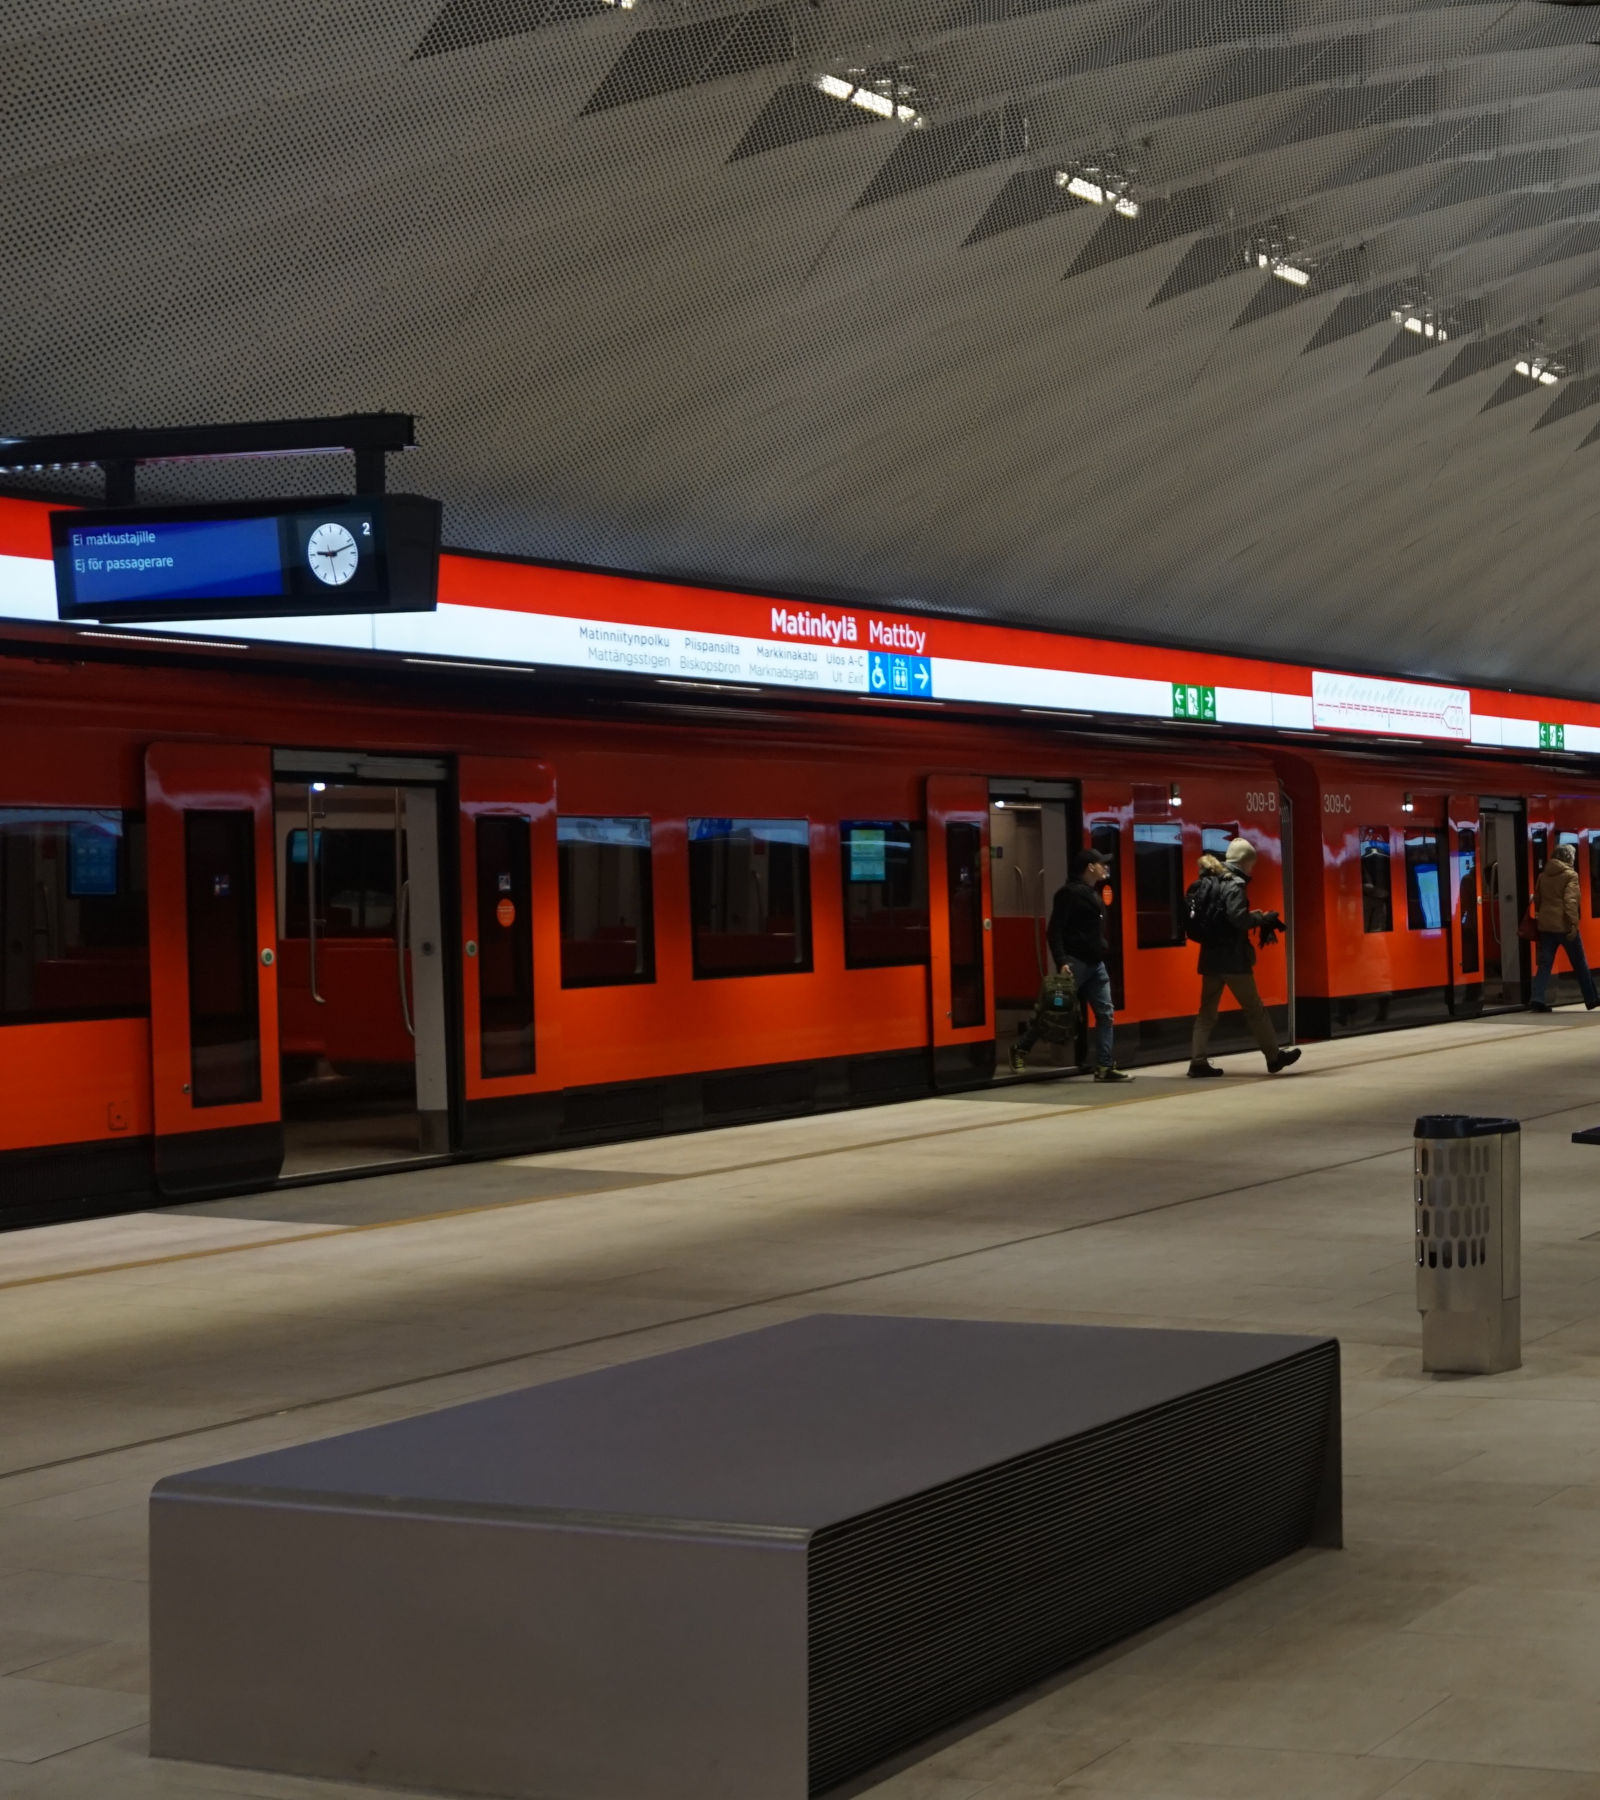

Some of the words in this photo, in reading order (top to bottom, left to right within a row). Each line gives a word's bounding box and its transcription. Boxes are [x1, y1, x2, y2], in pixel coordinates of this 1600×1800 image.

[73, 534, 83, 546] Ei
[86, 530, 156, 548] matkustajille
[362, 522, 371, 536] 2
[74, 558, 85, 574] Ej
[88, 556, 103, 571] för
[106, 555, 174, 573] passagerare
[770, 606, 858, 644] Matinkylä
[868, 619, 926, 654] Mattby
[684, 636, 741, 656] Piispansilta
[756, 645, 818, 663] Markkinakatu
[826, 652, 846, 666] Ulos
[1246, 791, 1276, 812] 309-B
[1323, 793, 1351, 813] 309-C
